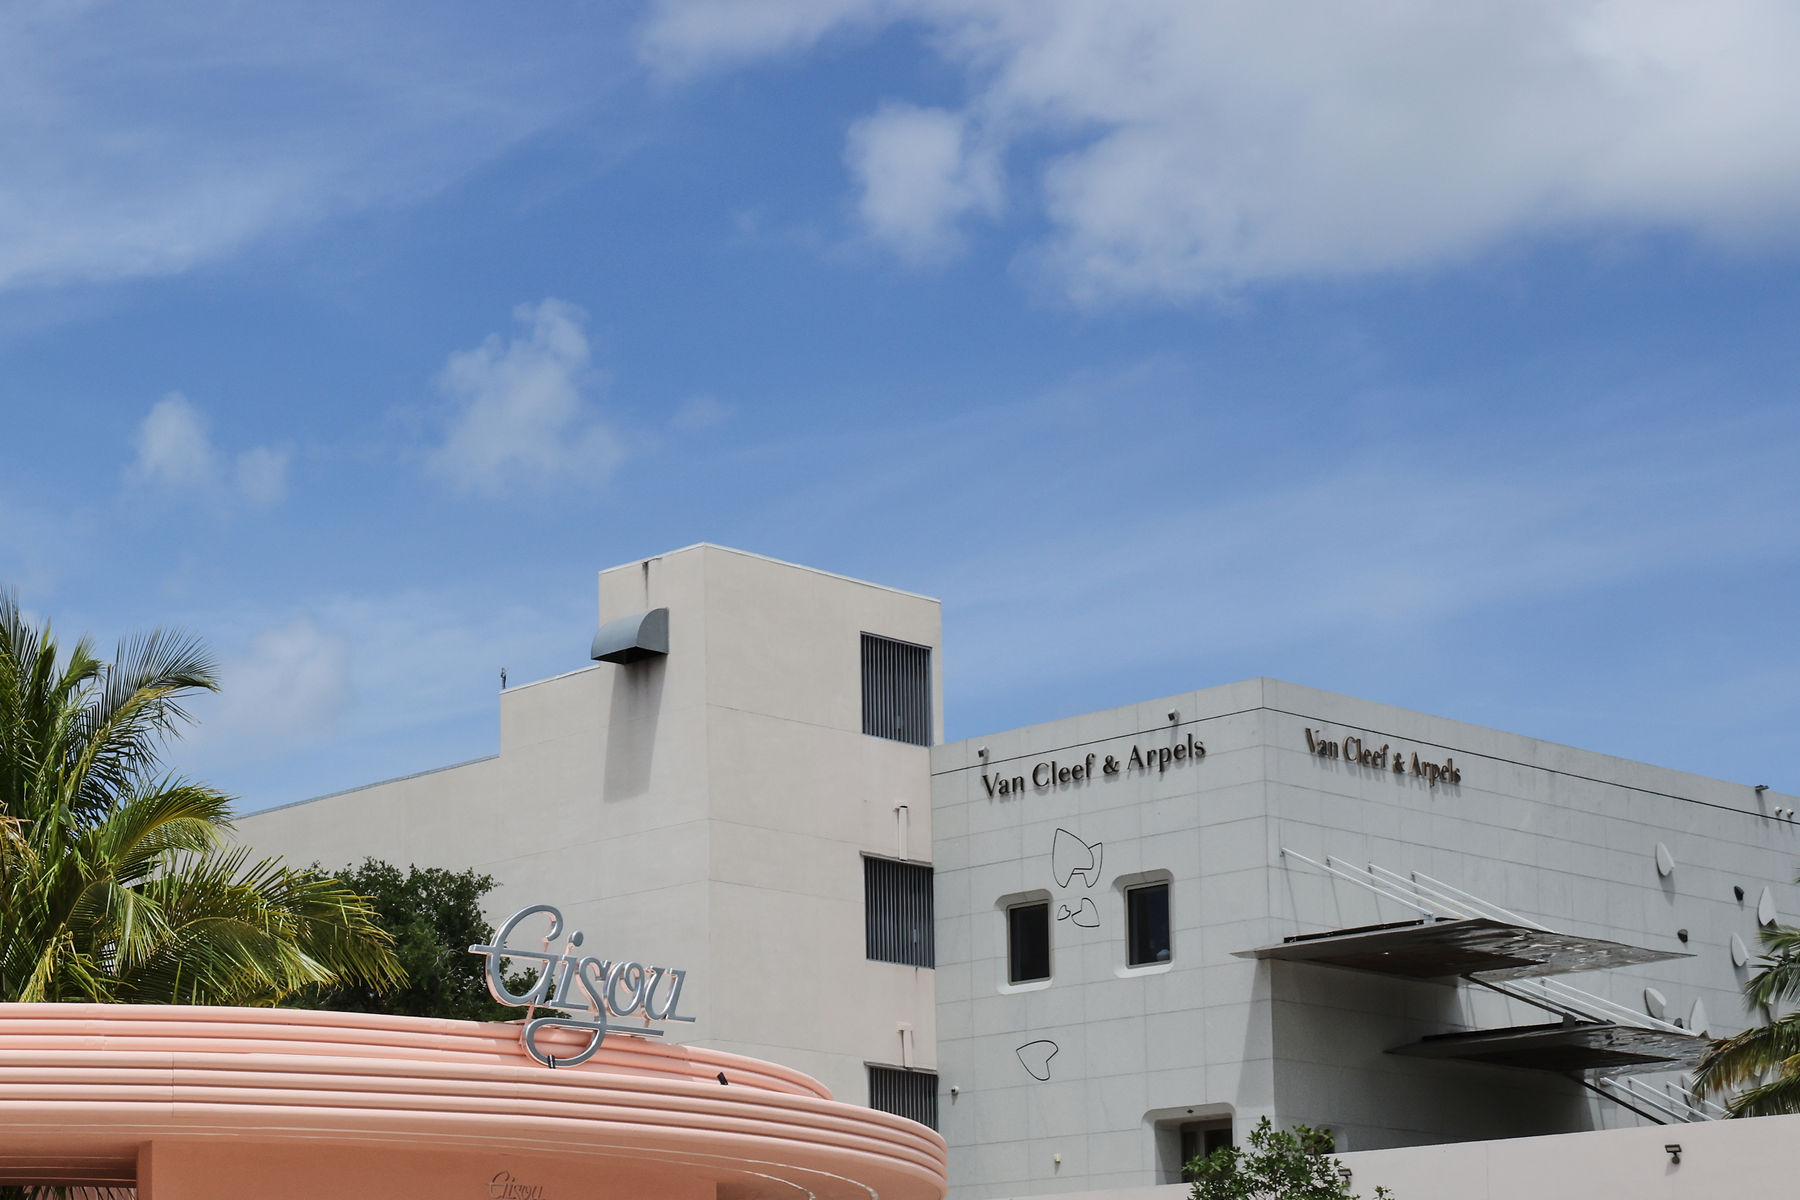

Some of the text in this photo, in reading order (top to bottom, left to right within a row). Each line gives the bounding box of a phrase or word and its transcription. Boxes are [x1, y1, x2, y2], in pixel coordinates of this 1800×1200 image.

[982, 733, 1206, 797] Van Cleef & Arpels
[1305, 728, 1462, 788] Van Cleef & Arpels
[468, 904, 696, 1067] Gisou
